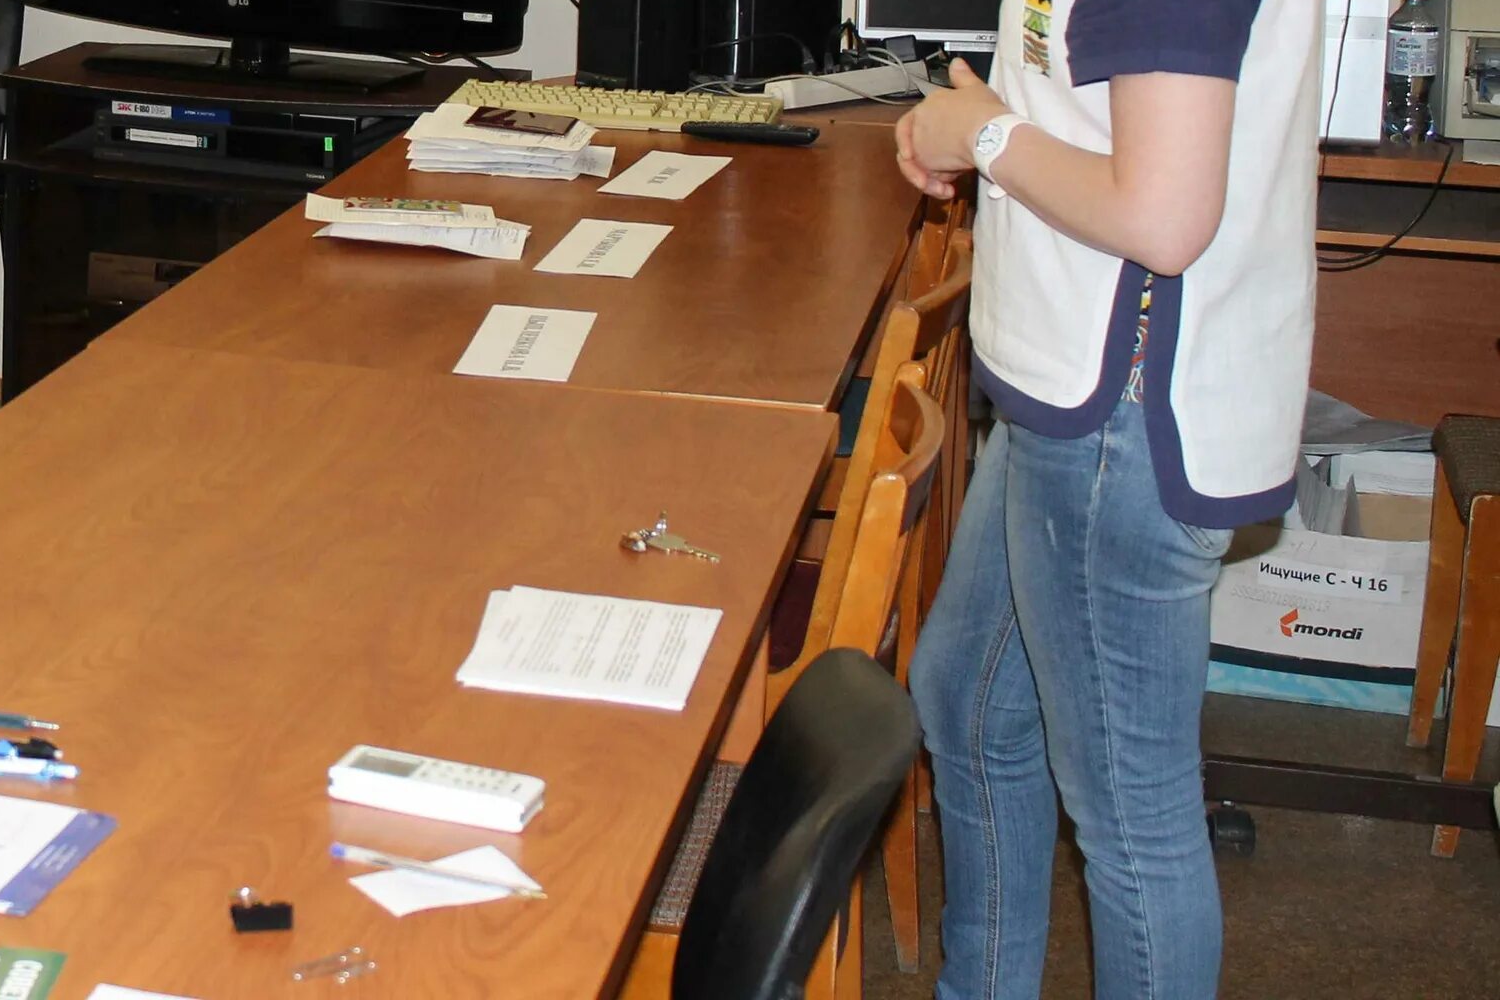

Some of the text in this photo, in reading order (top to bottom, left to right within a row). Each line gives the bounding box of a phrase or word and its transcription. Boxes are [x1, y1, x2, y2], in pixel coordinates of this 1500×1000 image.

[1260, 562, 1320, 582] Ищущие
[1326, 572, 1337, 585] С
[1351, 576, 1362, 589] Ч
[1368, 578, 1388, 592] 16
[1294, 623, 1364, 640] mondi
